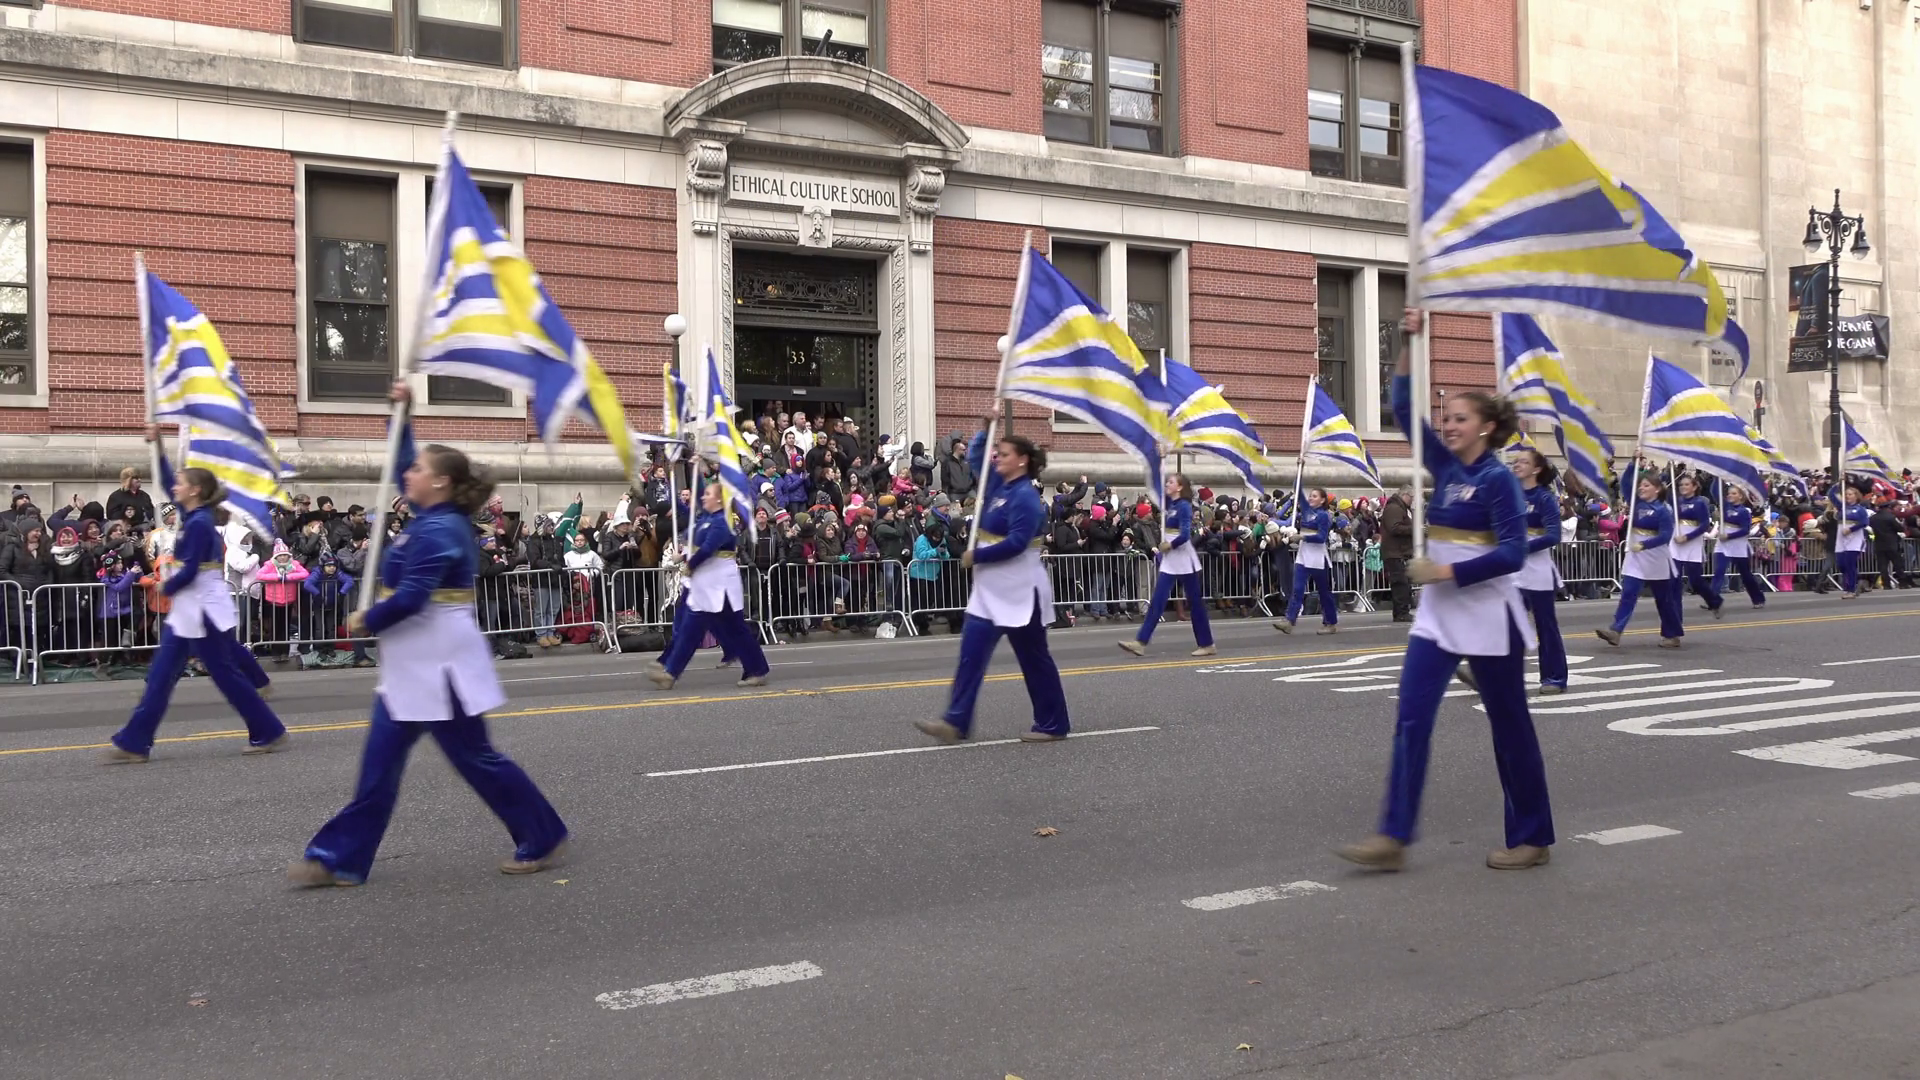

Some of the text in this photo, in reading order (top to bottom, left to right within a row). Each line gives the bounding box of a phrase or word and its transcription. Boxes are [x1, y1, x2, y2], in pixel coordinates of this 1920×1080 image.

[732, 174, 898, 209] ETHICAL CULTURE SCHOOL
[789, 350, 806, 365] 33
